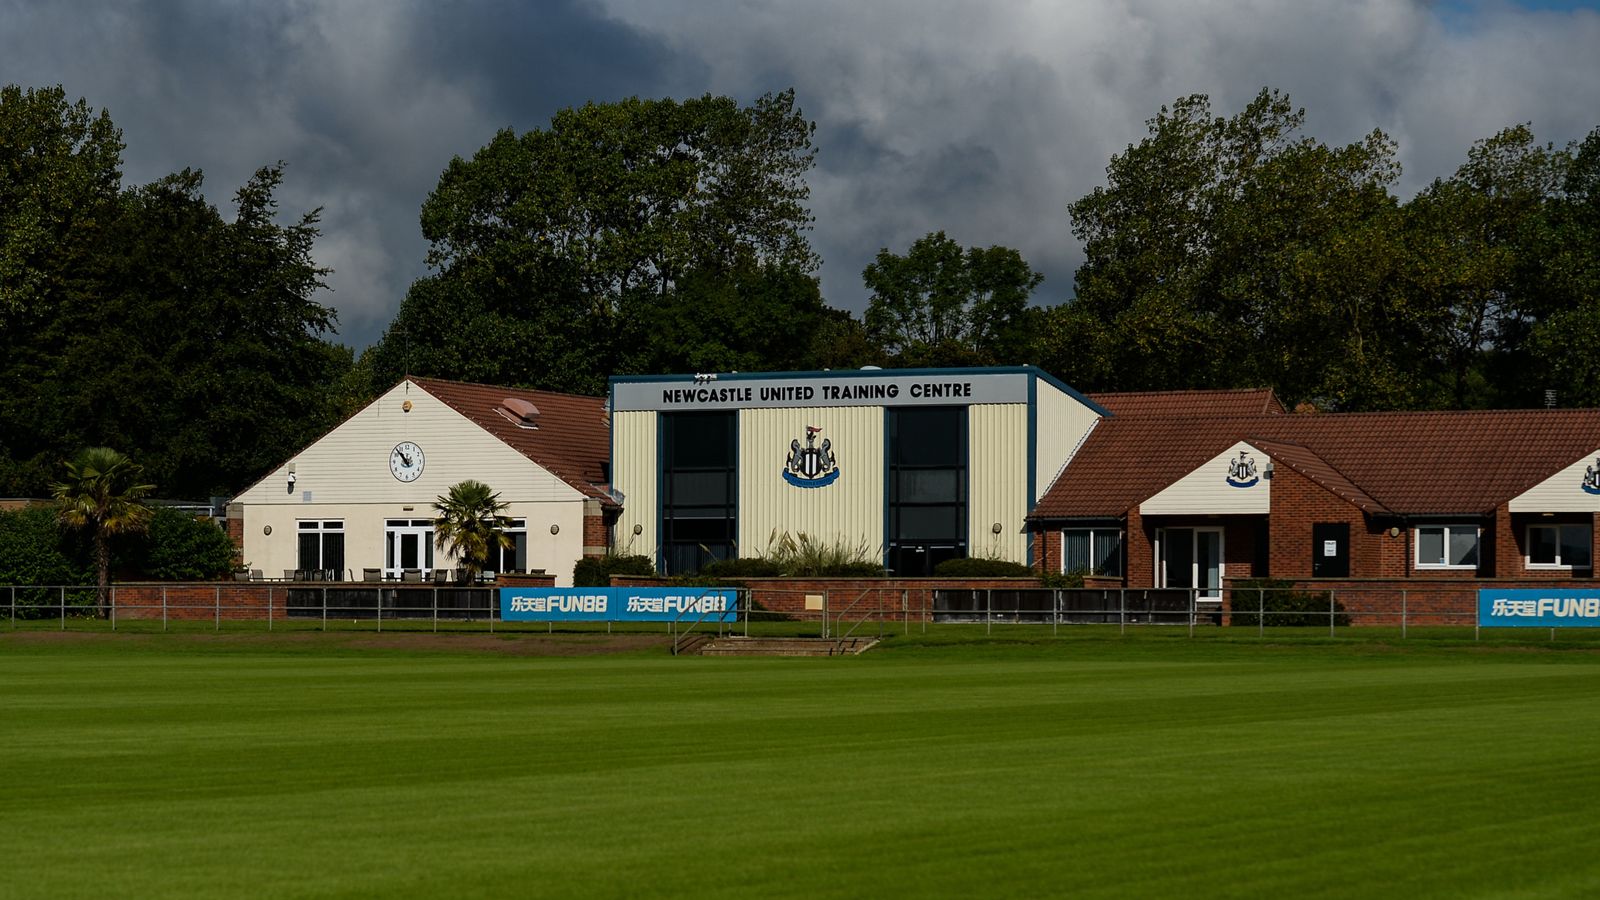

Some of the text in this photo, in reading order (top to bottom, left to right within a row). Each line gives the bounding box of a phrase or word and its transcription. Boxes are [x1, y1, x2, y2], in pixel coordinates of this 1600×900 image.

[663, 383, 971, 403] NEWCASTLE UNITED TRAINING CENTRE
[547, 595, 608, 612] FUN88
[664, 596, 727, 613] FUN88
[1537, 598, 1600, 617] FUN8
